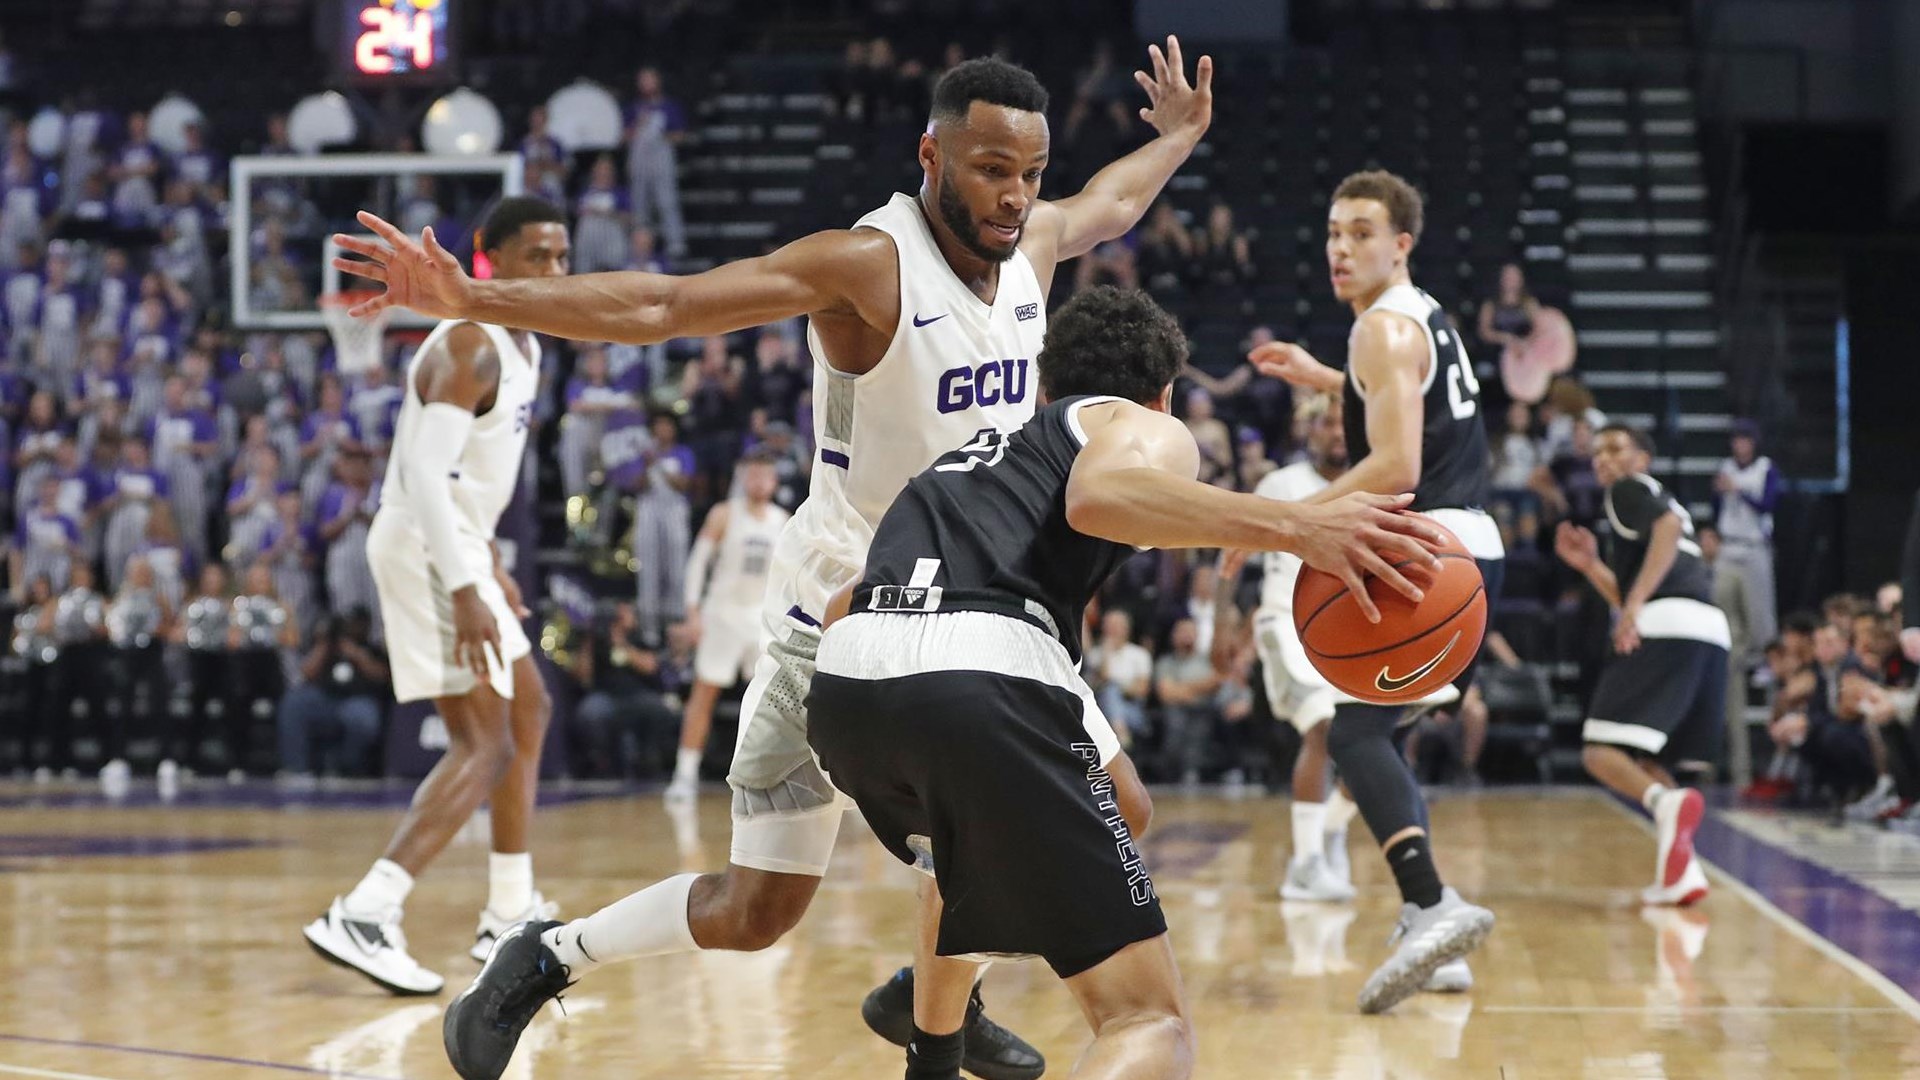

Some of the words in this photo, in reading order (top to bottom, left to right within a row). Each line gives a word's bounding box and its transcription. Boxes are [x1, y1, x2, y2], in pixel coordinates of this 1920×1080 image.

[356, 6, 432, 73] 24
[1016, 304, 1037, 320] WAC
[937, 359, 1028, 414] GCU
